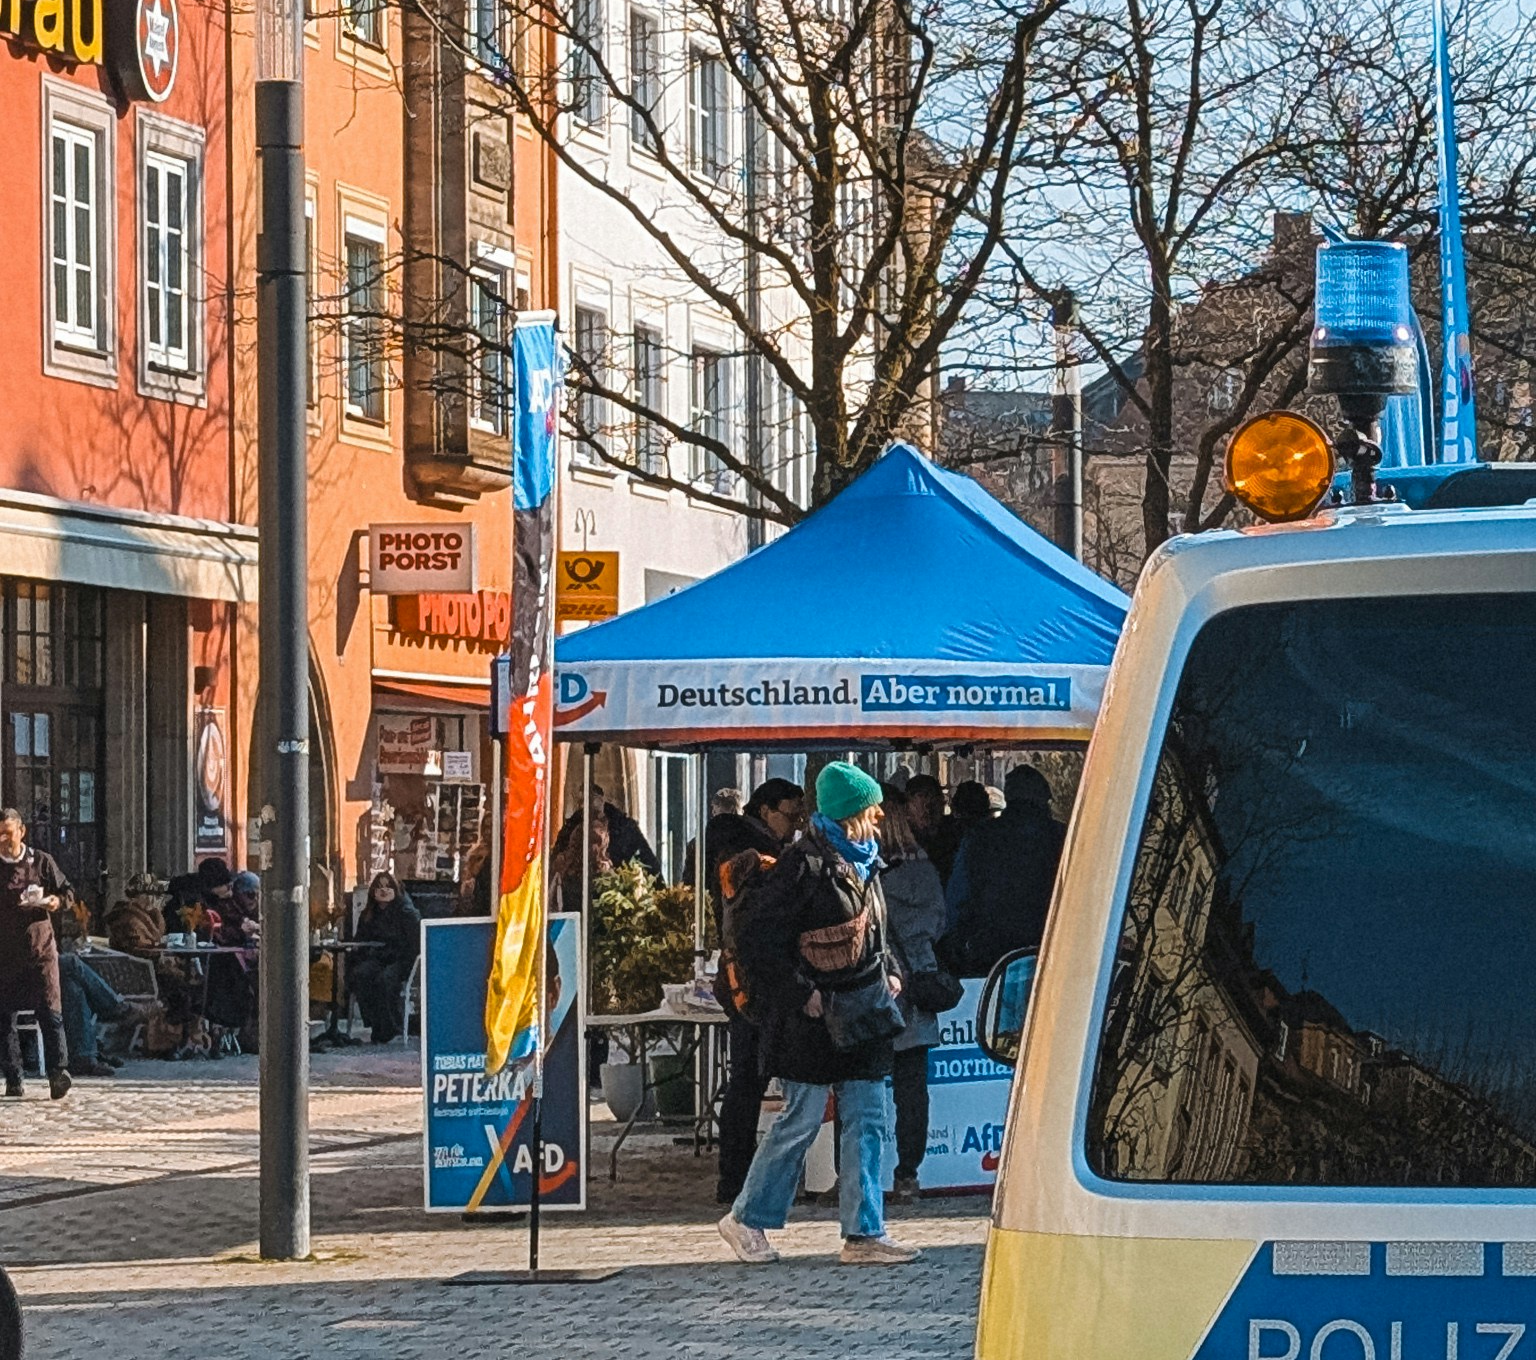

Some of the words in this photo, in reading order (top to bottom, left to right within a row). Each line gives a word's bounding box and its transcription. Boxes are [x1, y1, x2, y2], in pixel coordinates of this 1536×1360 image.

[379, 532, 462, 551] PHOTO
[379, 552, 462, 571] PORST
[418, 591, 481, 638] PHOTO
[483, 591, 512, 641] PO
[558, 603, 608, 616] DHL
[657, 678, 858, 708] Deutschland.
[865, 678, 940, 705] Aber
[946, 682, 1066, 707] normal.
[934, 1057, 1014, 1078] norma
[433, 1071, 526, 1104] PETERKA
